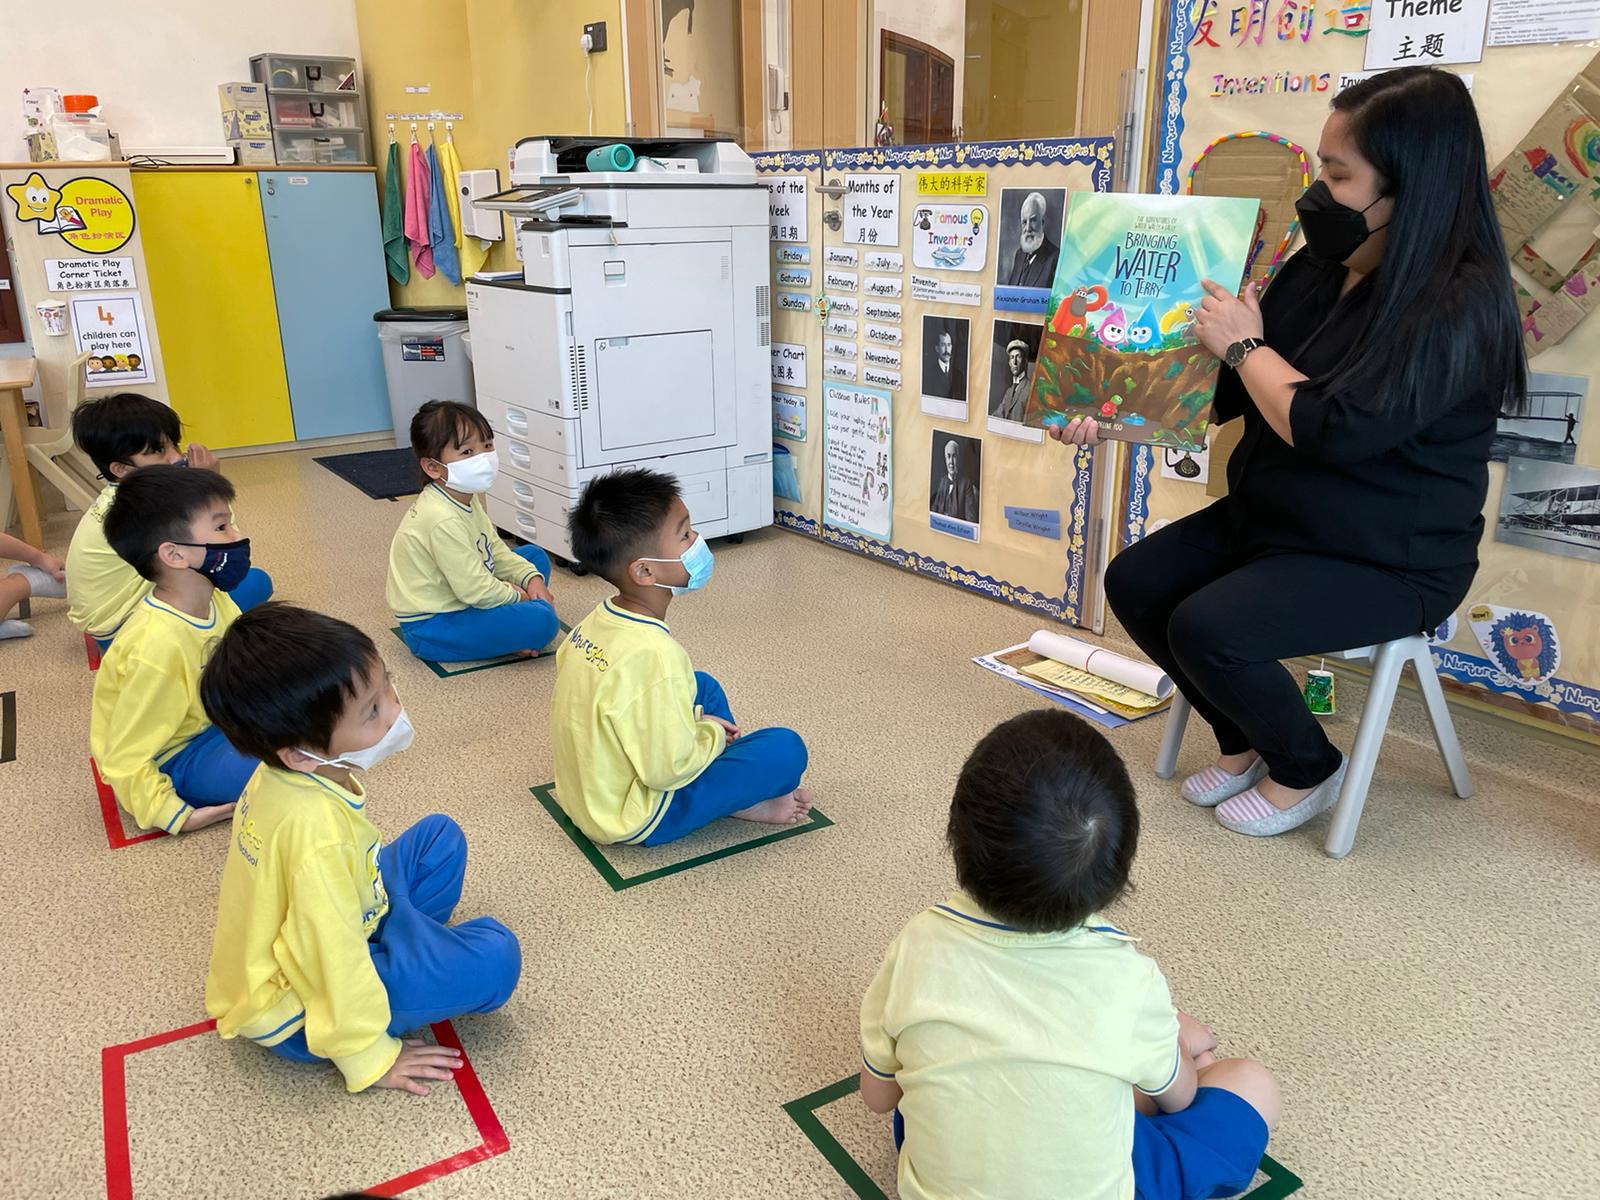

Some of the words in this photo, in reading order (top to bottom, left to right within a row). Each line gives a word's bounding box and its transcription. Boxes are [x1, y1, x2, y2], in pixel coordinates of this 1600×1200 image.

[1386, 0, 1463, 18] Theme
[1393, 33, 1445, 61] 主题
[1210, 72, 1331, 97] Inventions
[776, 181, 786, 194] of
[790, 182, 804, 193] the
[848, 180, 880, 194] Months
[884, 180, 894, 194] of
[919, 176, 985, 191] 伟大的科学家
[75, 196, 123, 205] Dramatic
[90, 208, 113, 218] Play
[852, 205, 867, 218] the
[871, 205, 894, 219] Year
[935, 210, 969, 225] Famous
[858, 228, 878, 242] 月份
[928, 232, 973, 246] Inventors
[1125, 231, 1178, 249] BRINGING
[783, 250, 802, 261] Friday
[829, 252, 853, 264] January
[58, 260, 99, 268] Dramatic
[102, 259, 121, 268] Play
[876, 257, 890, 268] July
[1115, 245, 1181, 284] WATER
[59, 270, 90, 279] Corner
[93, 269, 122, 277] Ticket
[780, 274, 807, 285] Saturday
[827, 275, 855, 290] February
[912, 276, 938, 288] Inventor
[1120, 280, 1132, 296] TO
[1135, 277, 1164, 298] TERRY
[871, 283, 894, 294] August
[782, 298, 805, 310] Sunday
[832, 300, 851, 311] March
[98, 304, 115, 326] 4
[866, 306, 900, 318] September
[833, 323, 848, 334] April
[82, 330, 118, 341] children
[119, 330, 136, 338] can
[869, 329, 897, 341] October
[90, 340, 110, 351] play
[111, 339, 132, 349] here
[834, 345, 847, 356] May
[783, 348, 805, 360] Chart
[865, 351, 898, 364] November
[833, 365, 847, 376] June
[865, 372, 898, 386] December
[784, 397, 798, 408] today
[800, 400, 805, 408] is
